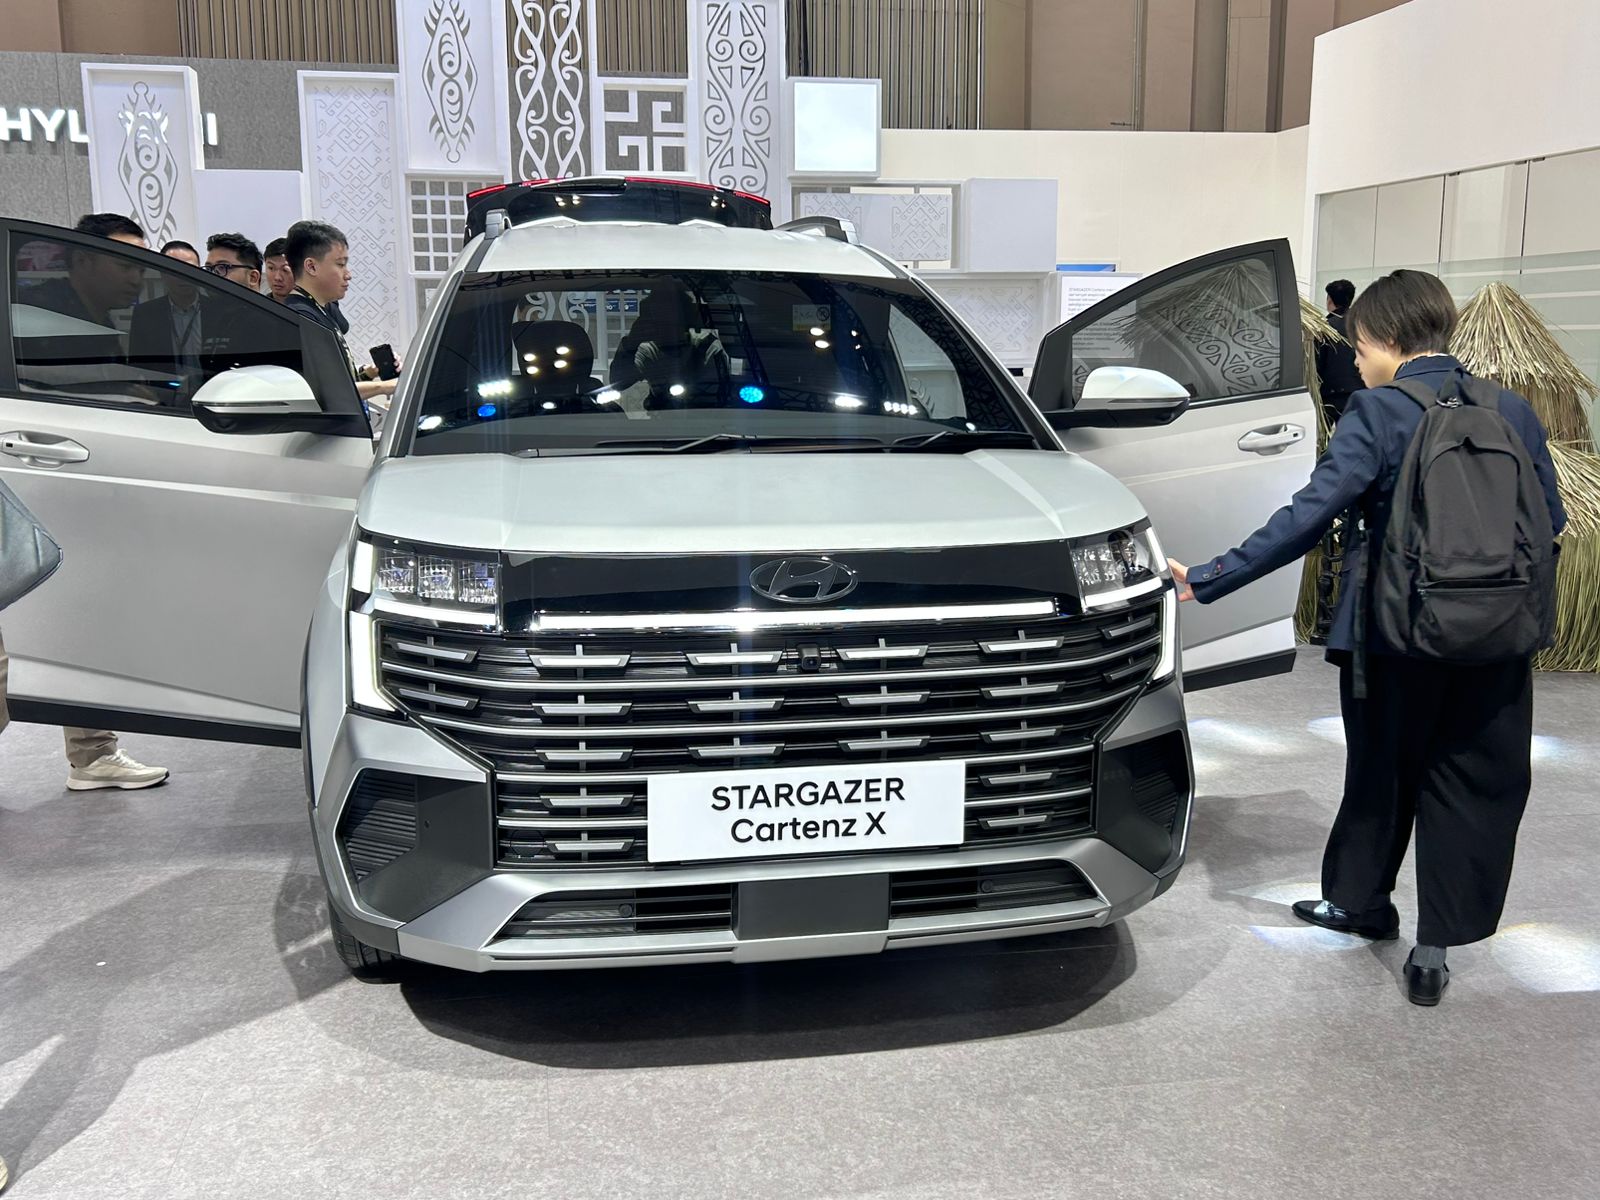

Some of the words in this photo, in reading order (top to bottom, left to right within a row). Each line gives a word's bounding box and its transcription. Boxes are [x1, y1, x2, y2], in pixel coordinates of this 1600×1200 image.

[711, 777, 906, 812] STARGAZER
[730, 816, 857, 844] Cartenz
[864, 811, 887, 836] X
